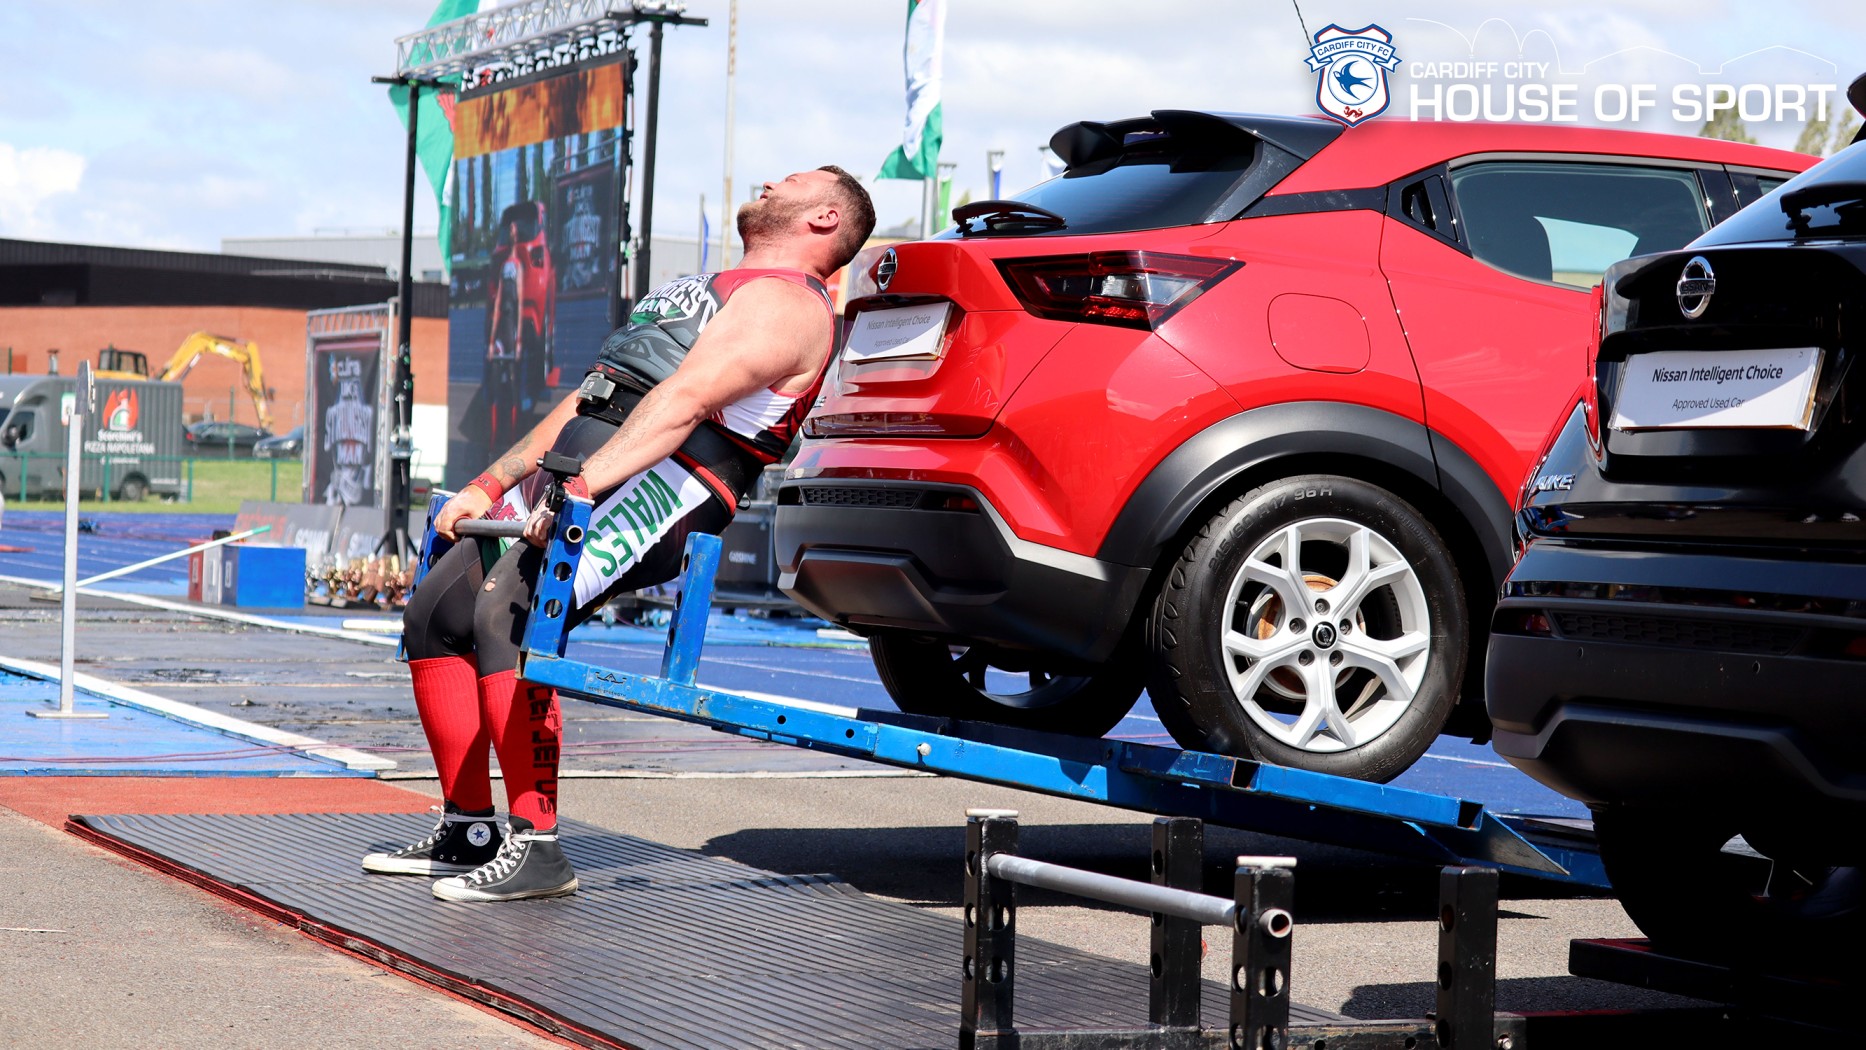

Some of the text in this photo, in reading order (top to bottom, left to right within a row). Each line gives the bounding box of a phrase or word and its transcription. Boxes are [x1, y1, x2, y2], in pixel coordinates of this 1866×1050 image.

[866, 314, 931, 330] Nissan Intelligent Choice
[1652, 363, 1783, 384] Nissan Intelligent Choice
[1672, 397, 1746, 410] Approved Used Car
[84, 441, 156, 455] PIZZA NAPOLETANA
[584, 469, 683, 577] WALES
